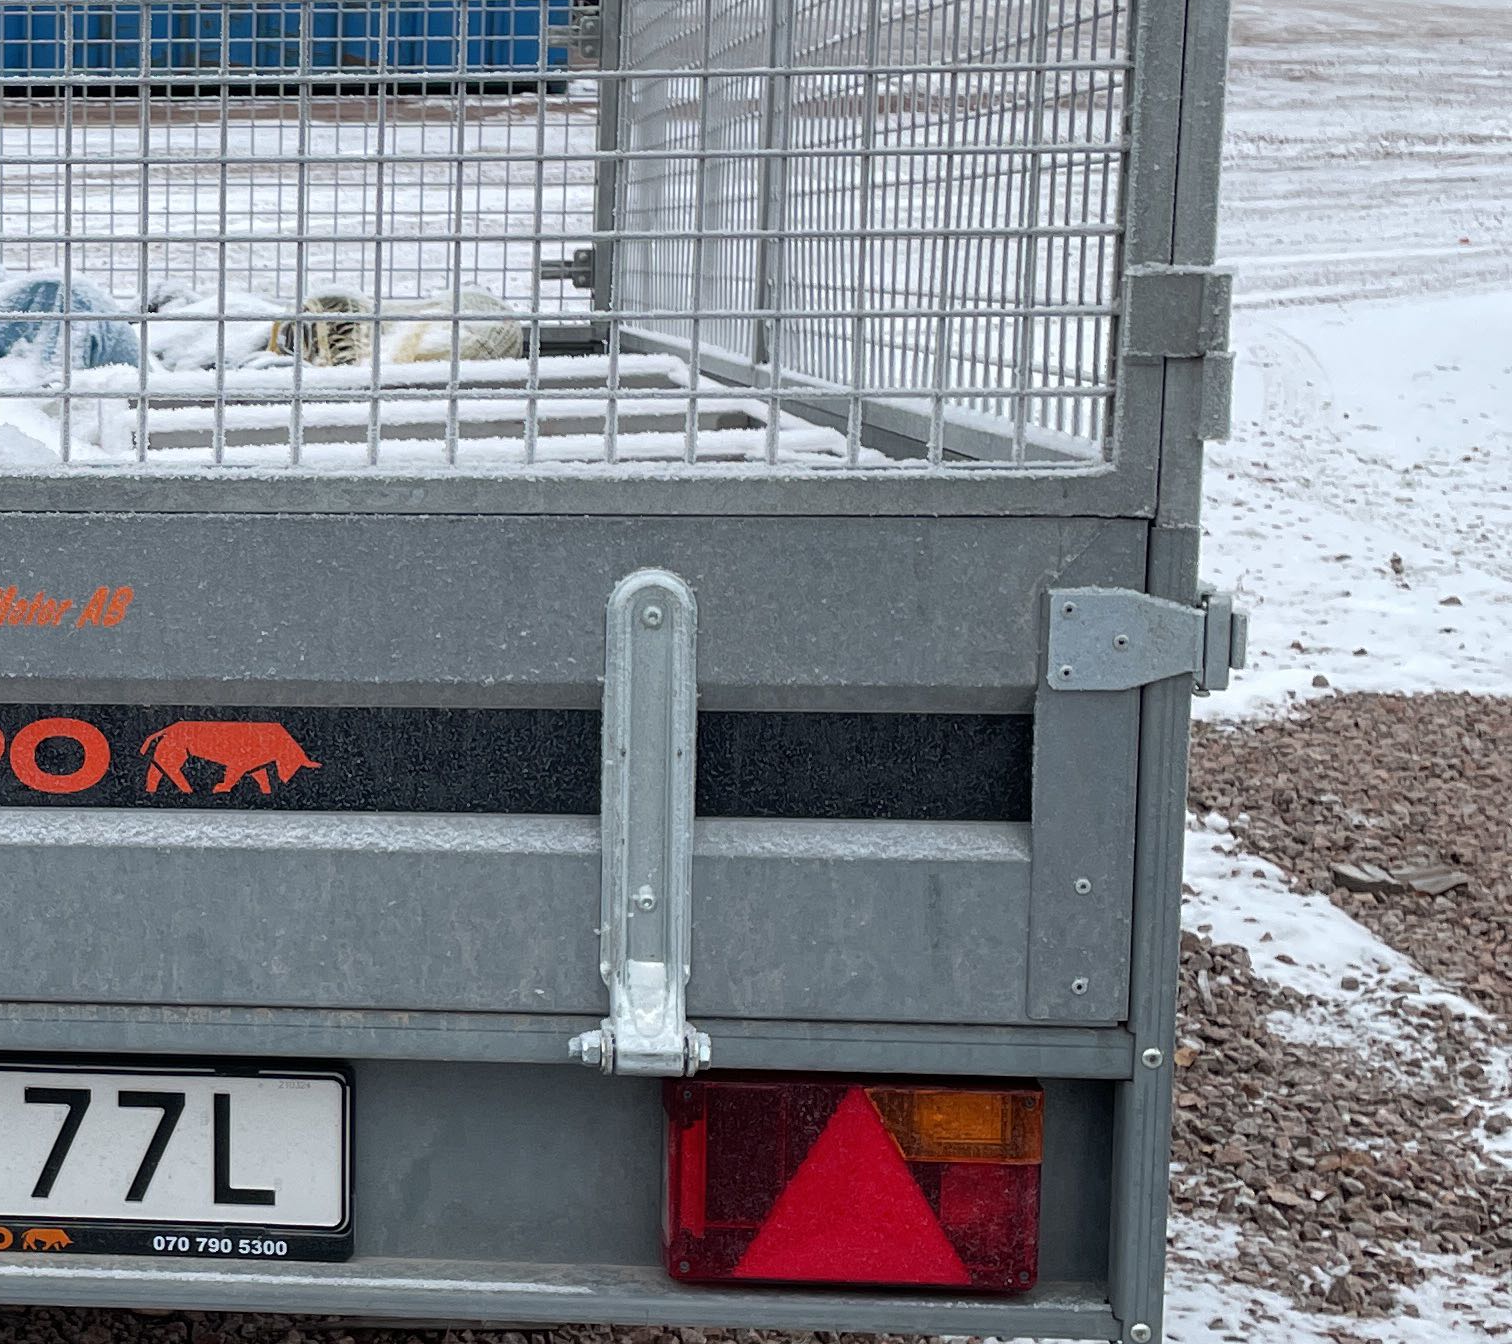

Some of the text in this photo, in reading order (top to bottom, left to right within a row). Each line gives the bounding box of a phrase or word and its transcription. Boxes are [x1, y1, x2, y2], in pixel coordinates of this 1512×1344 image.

[76, 585, 134, 628] AB
[23, 1086, 276, 1206] 77L
[152, 1235, 288, 1256] 070 790 5300
